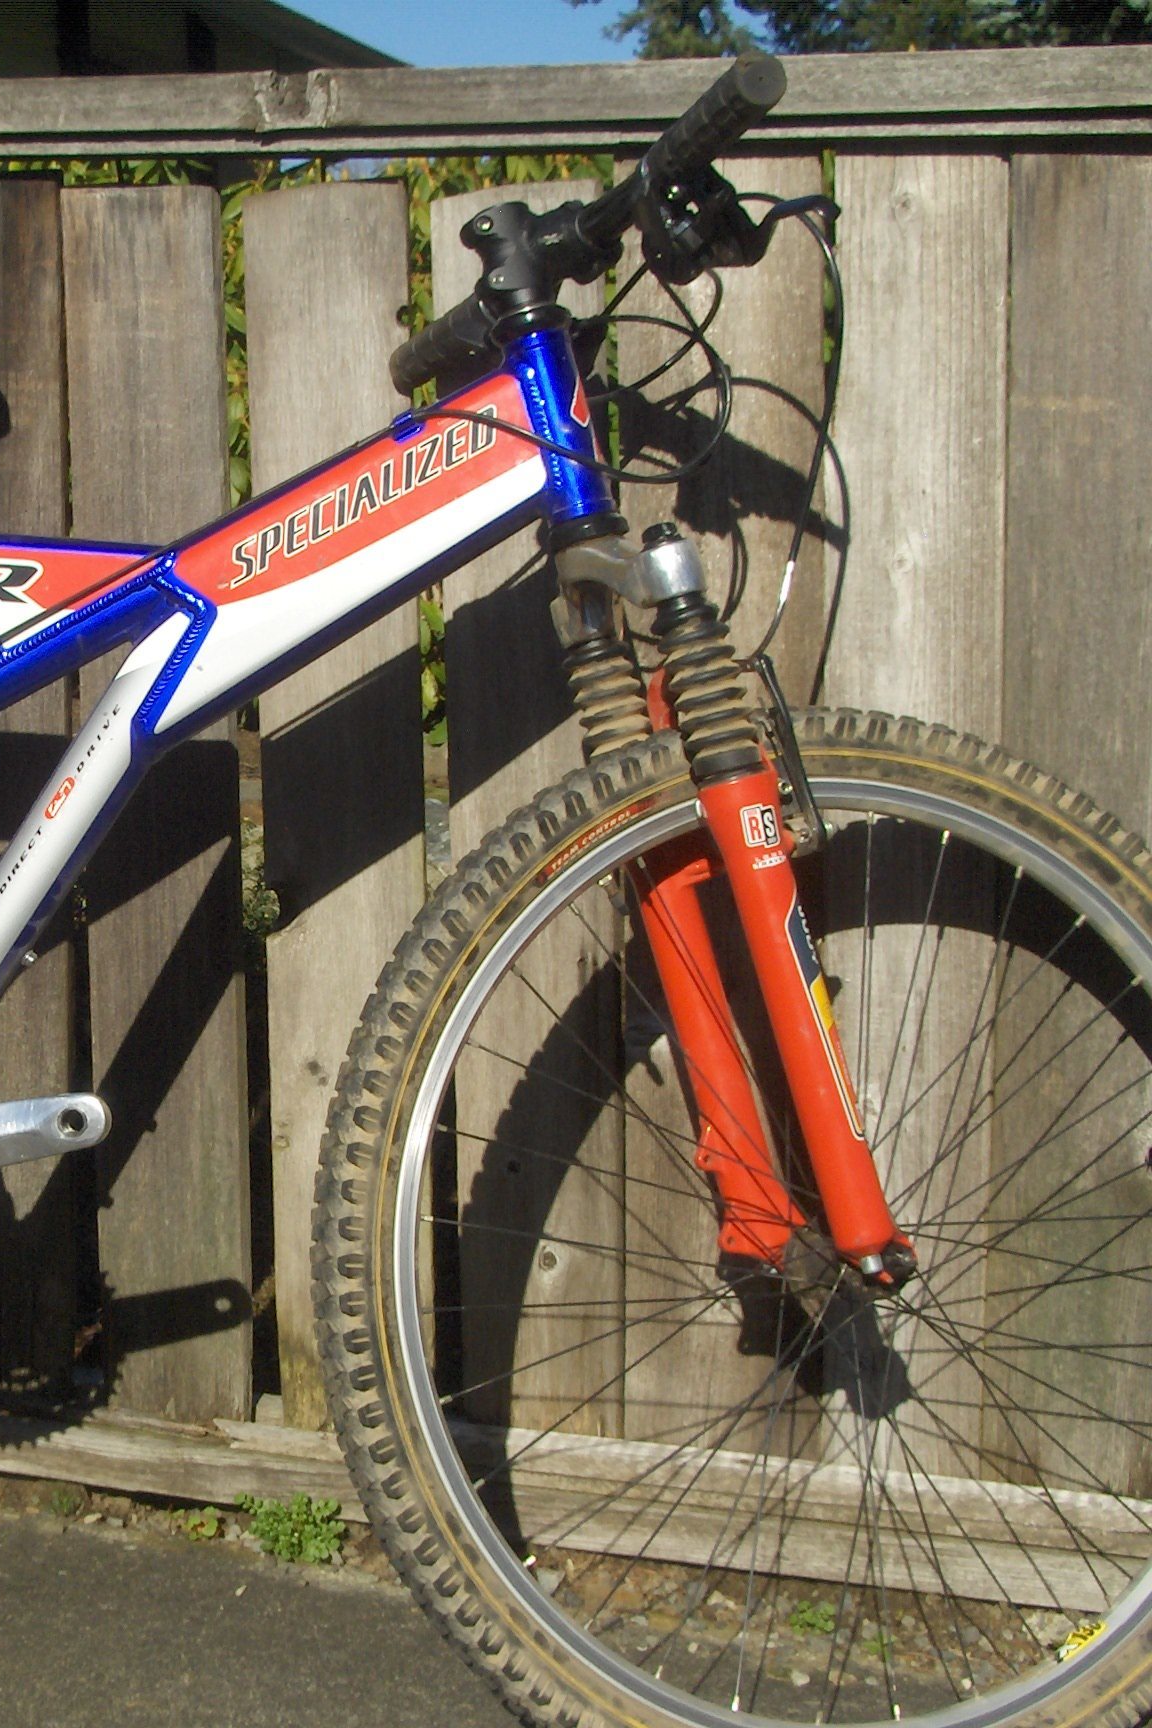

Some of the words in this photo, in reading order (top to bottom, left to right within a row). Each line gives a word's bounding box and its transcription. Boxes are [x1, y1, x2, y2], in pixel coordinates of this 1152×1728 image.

[230, 404, 498, 590] SPECIALIZED
[0, 826, 42, 894] DIRECT
[77, 704, 121, 773] DRIVE
[551, 844, 579, 870] TEAM
[582, 810, 631, 846] CONTROL
